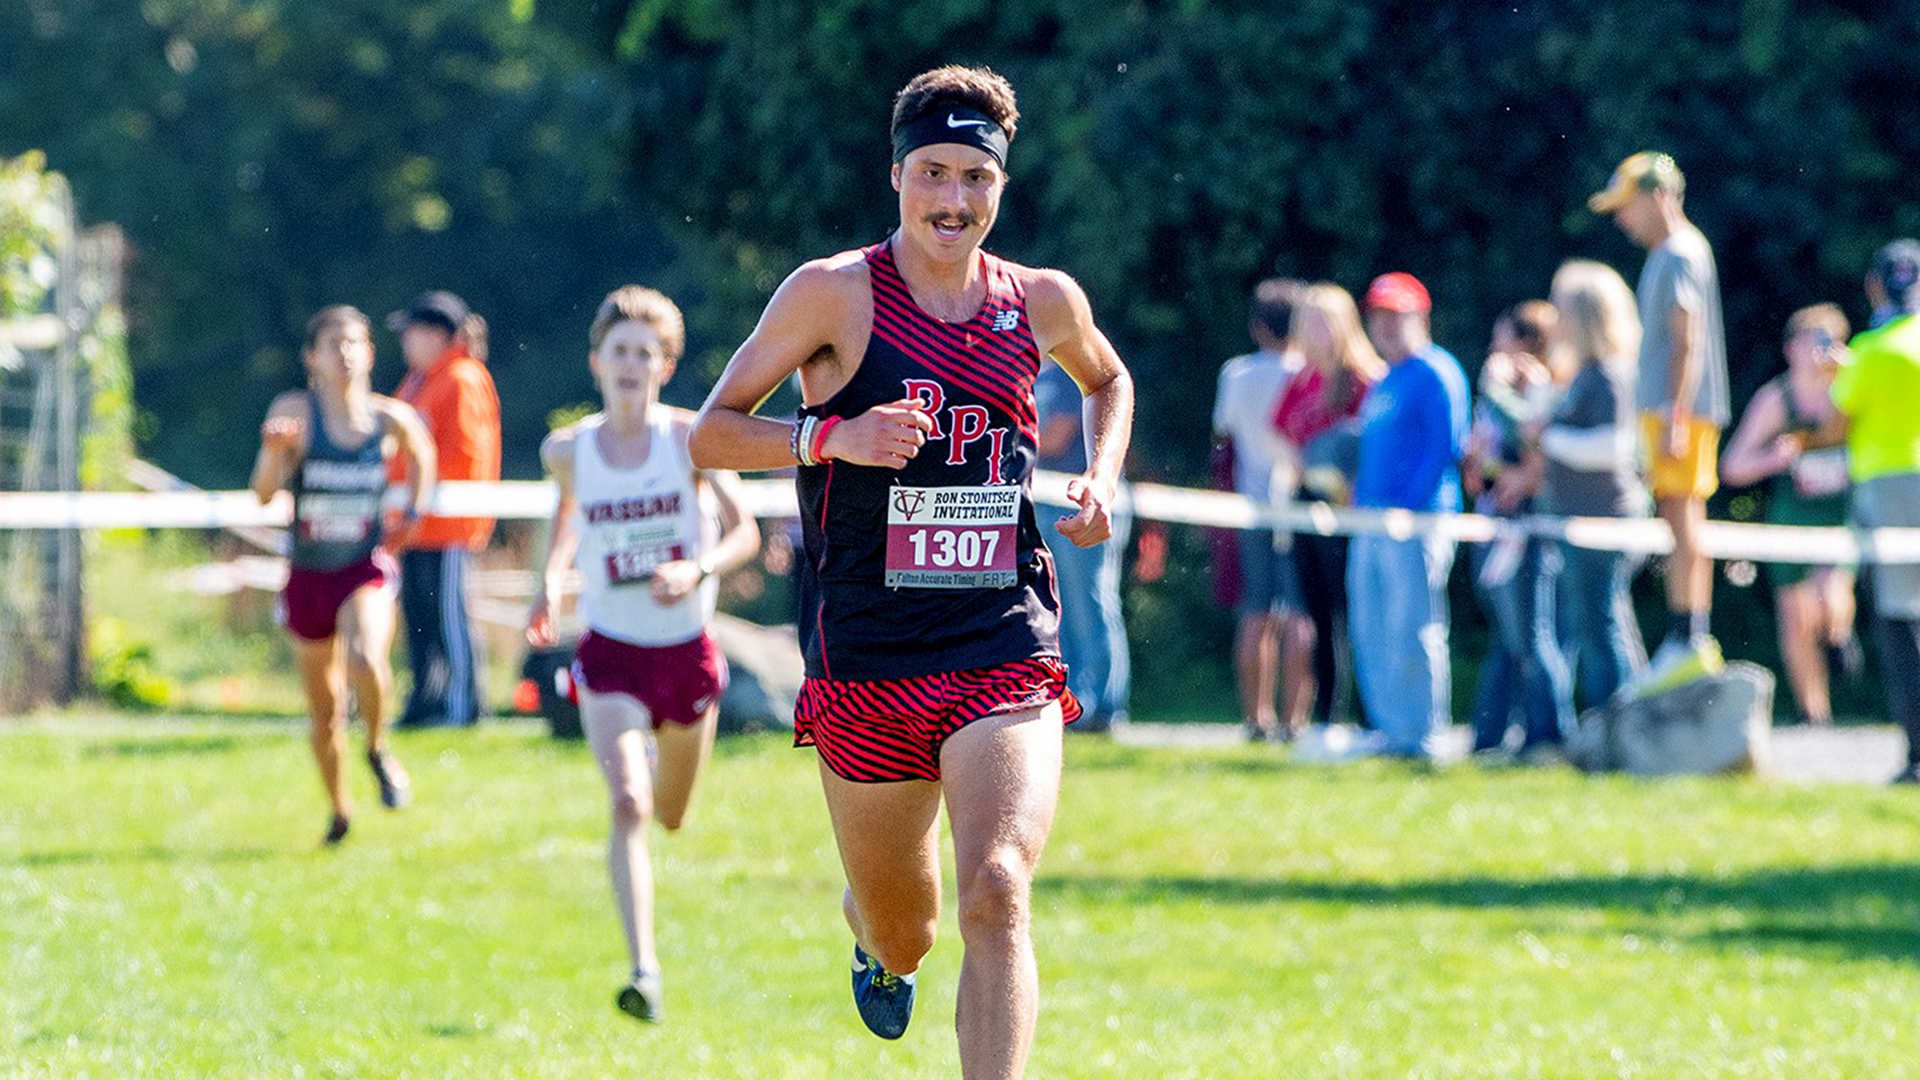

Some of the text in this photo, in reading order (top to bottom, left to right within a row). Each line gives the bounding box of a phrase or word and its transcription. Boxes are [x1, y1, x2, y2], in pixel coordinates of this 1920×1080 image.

[902, 379, 1008, 486] RPI
[934, 491, 1017, 504] RON STONITSCH
[933, 505, 1014, 519] INVITATIONAL
[909, 529, 1000, 567] 1307
